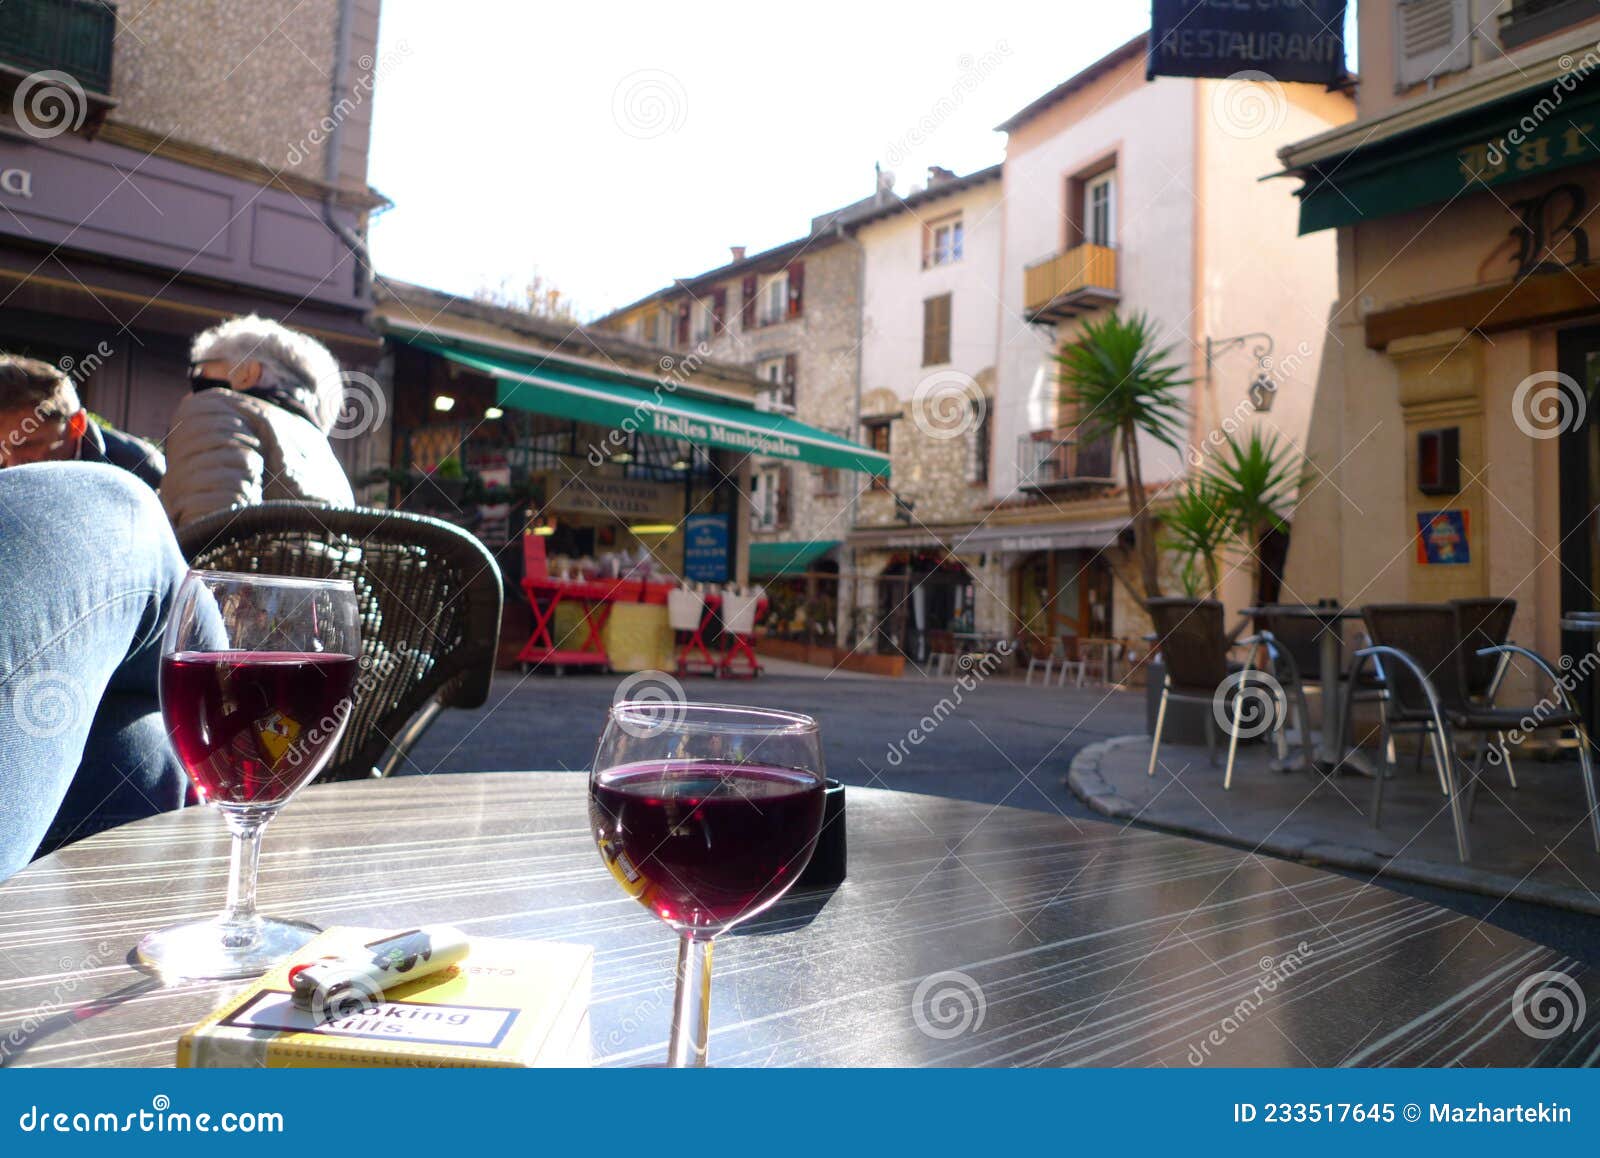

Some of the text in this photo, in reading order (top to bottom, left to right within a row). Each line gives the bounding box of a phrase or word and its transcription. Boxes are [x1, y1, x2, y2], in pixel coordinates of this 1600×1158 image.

[1161, 28, 1337, 63] RESTAURANT
[653, 411, 801, 458] Halles Municipales
